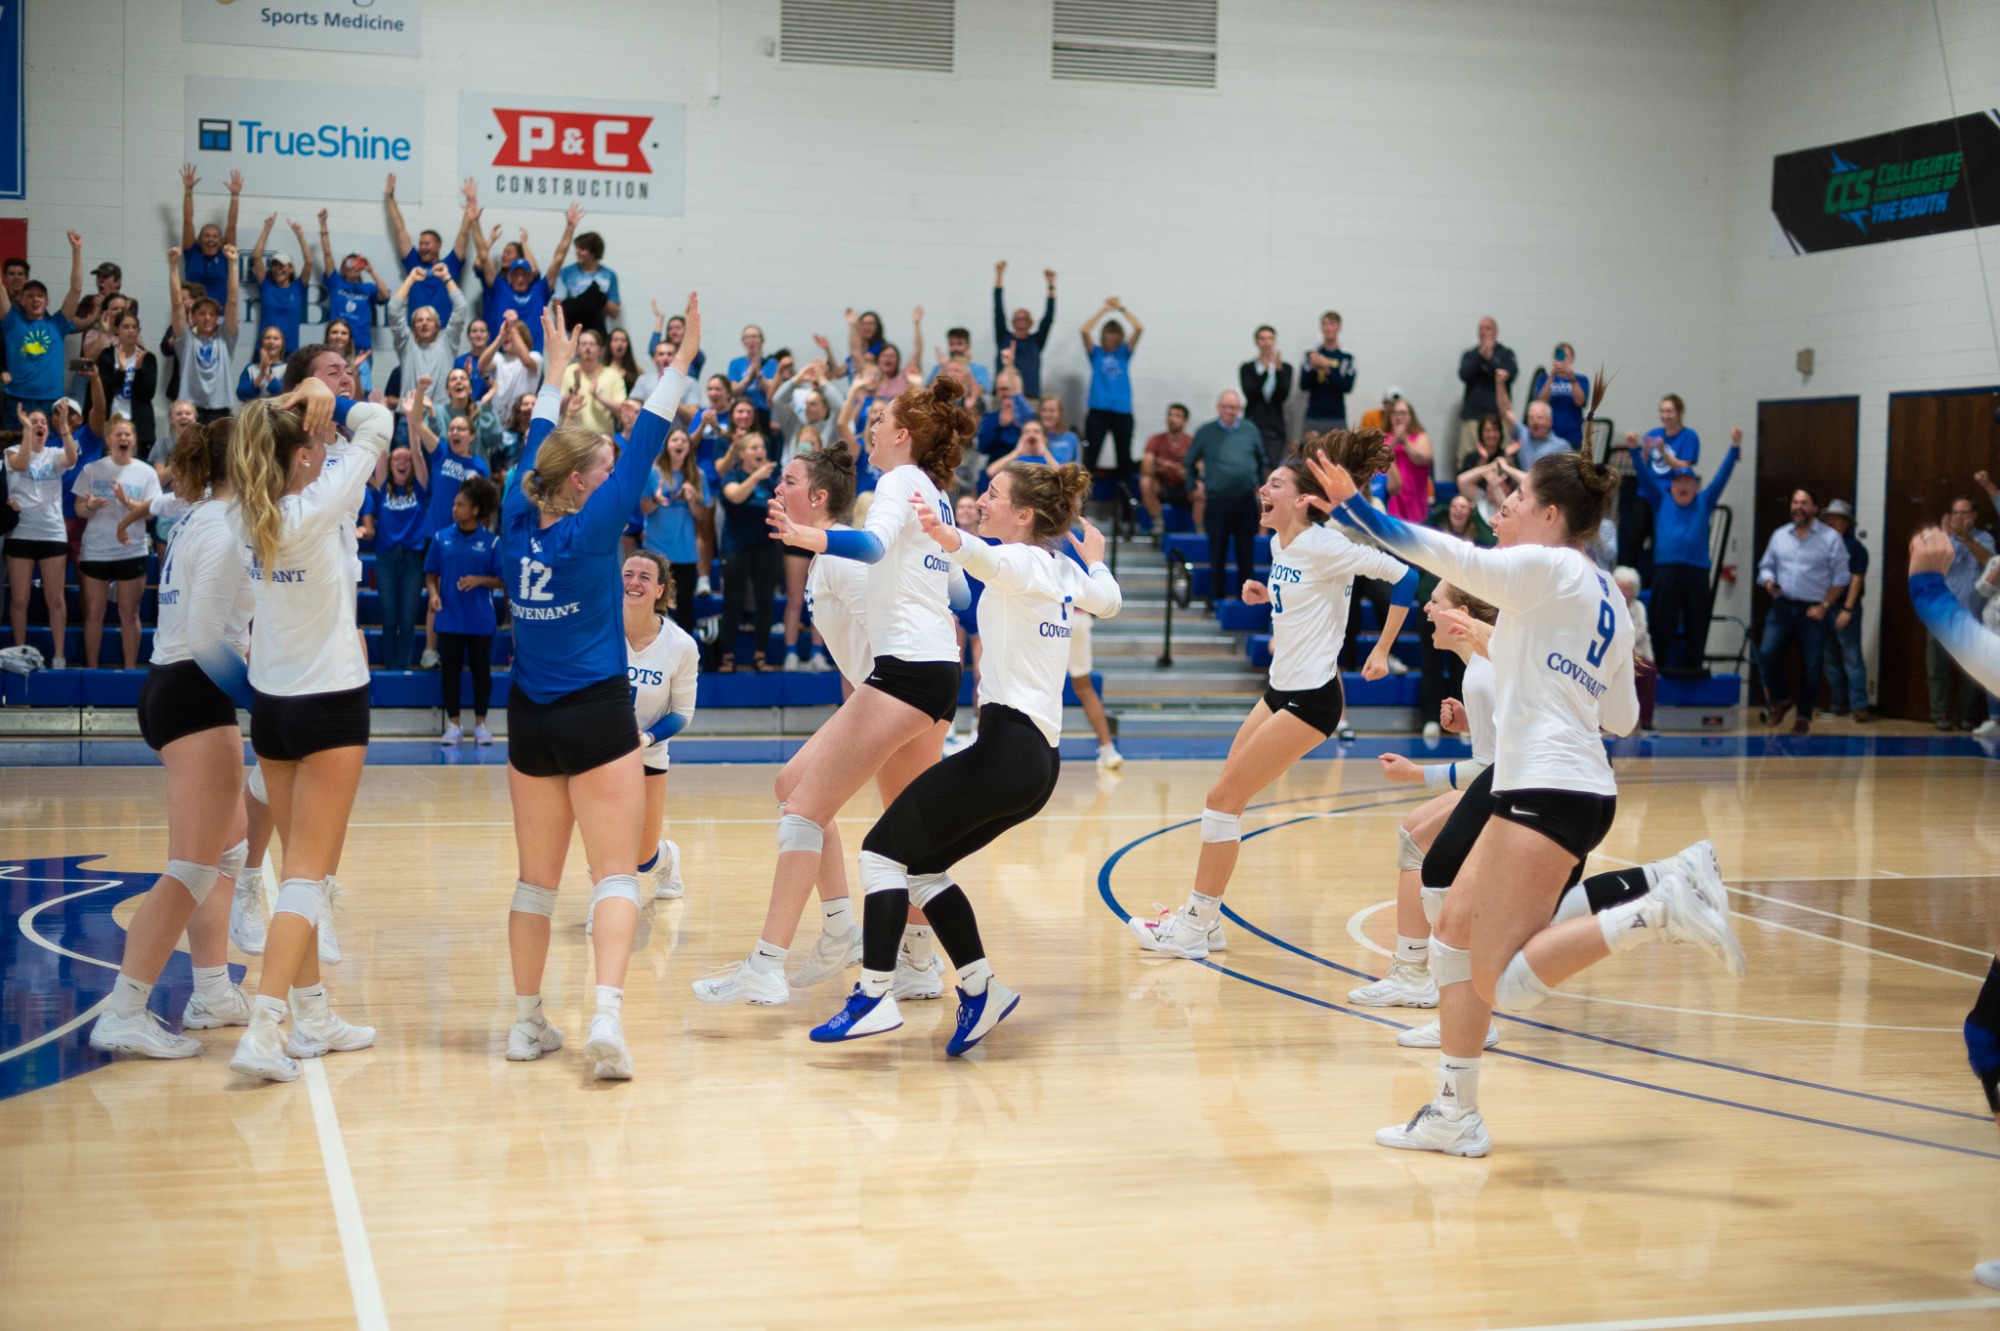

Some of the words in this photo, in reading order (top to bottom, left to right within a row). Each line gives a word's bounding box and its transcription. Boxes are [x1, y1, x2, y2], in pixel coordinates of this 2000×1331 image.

[261, 7, 319, 27] Sports
[324, 12, 405, 32] Medicine
[238, 120, 412, 161] TrueShine
[496, 174, 649, 199] CONSTRUCTION
[1877, 152, 1963, 186] COLLEGIATE
[1824, 168, 1875, 214] CCS
[1871, 200, 1900, 225] THE
[1899, 191, 1950, 219] SOUTH
[519, 556, 555, 601] 12
[1272, 583, 1283, 614] 3
[1586, 599, 1616, 669] 9
[1546, 652, 1608, 701] COVENANT
